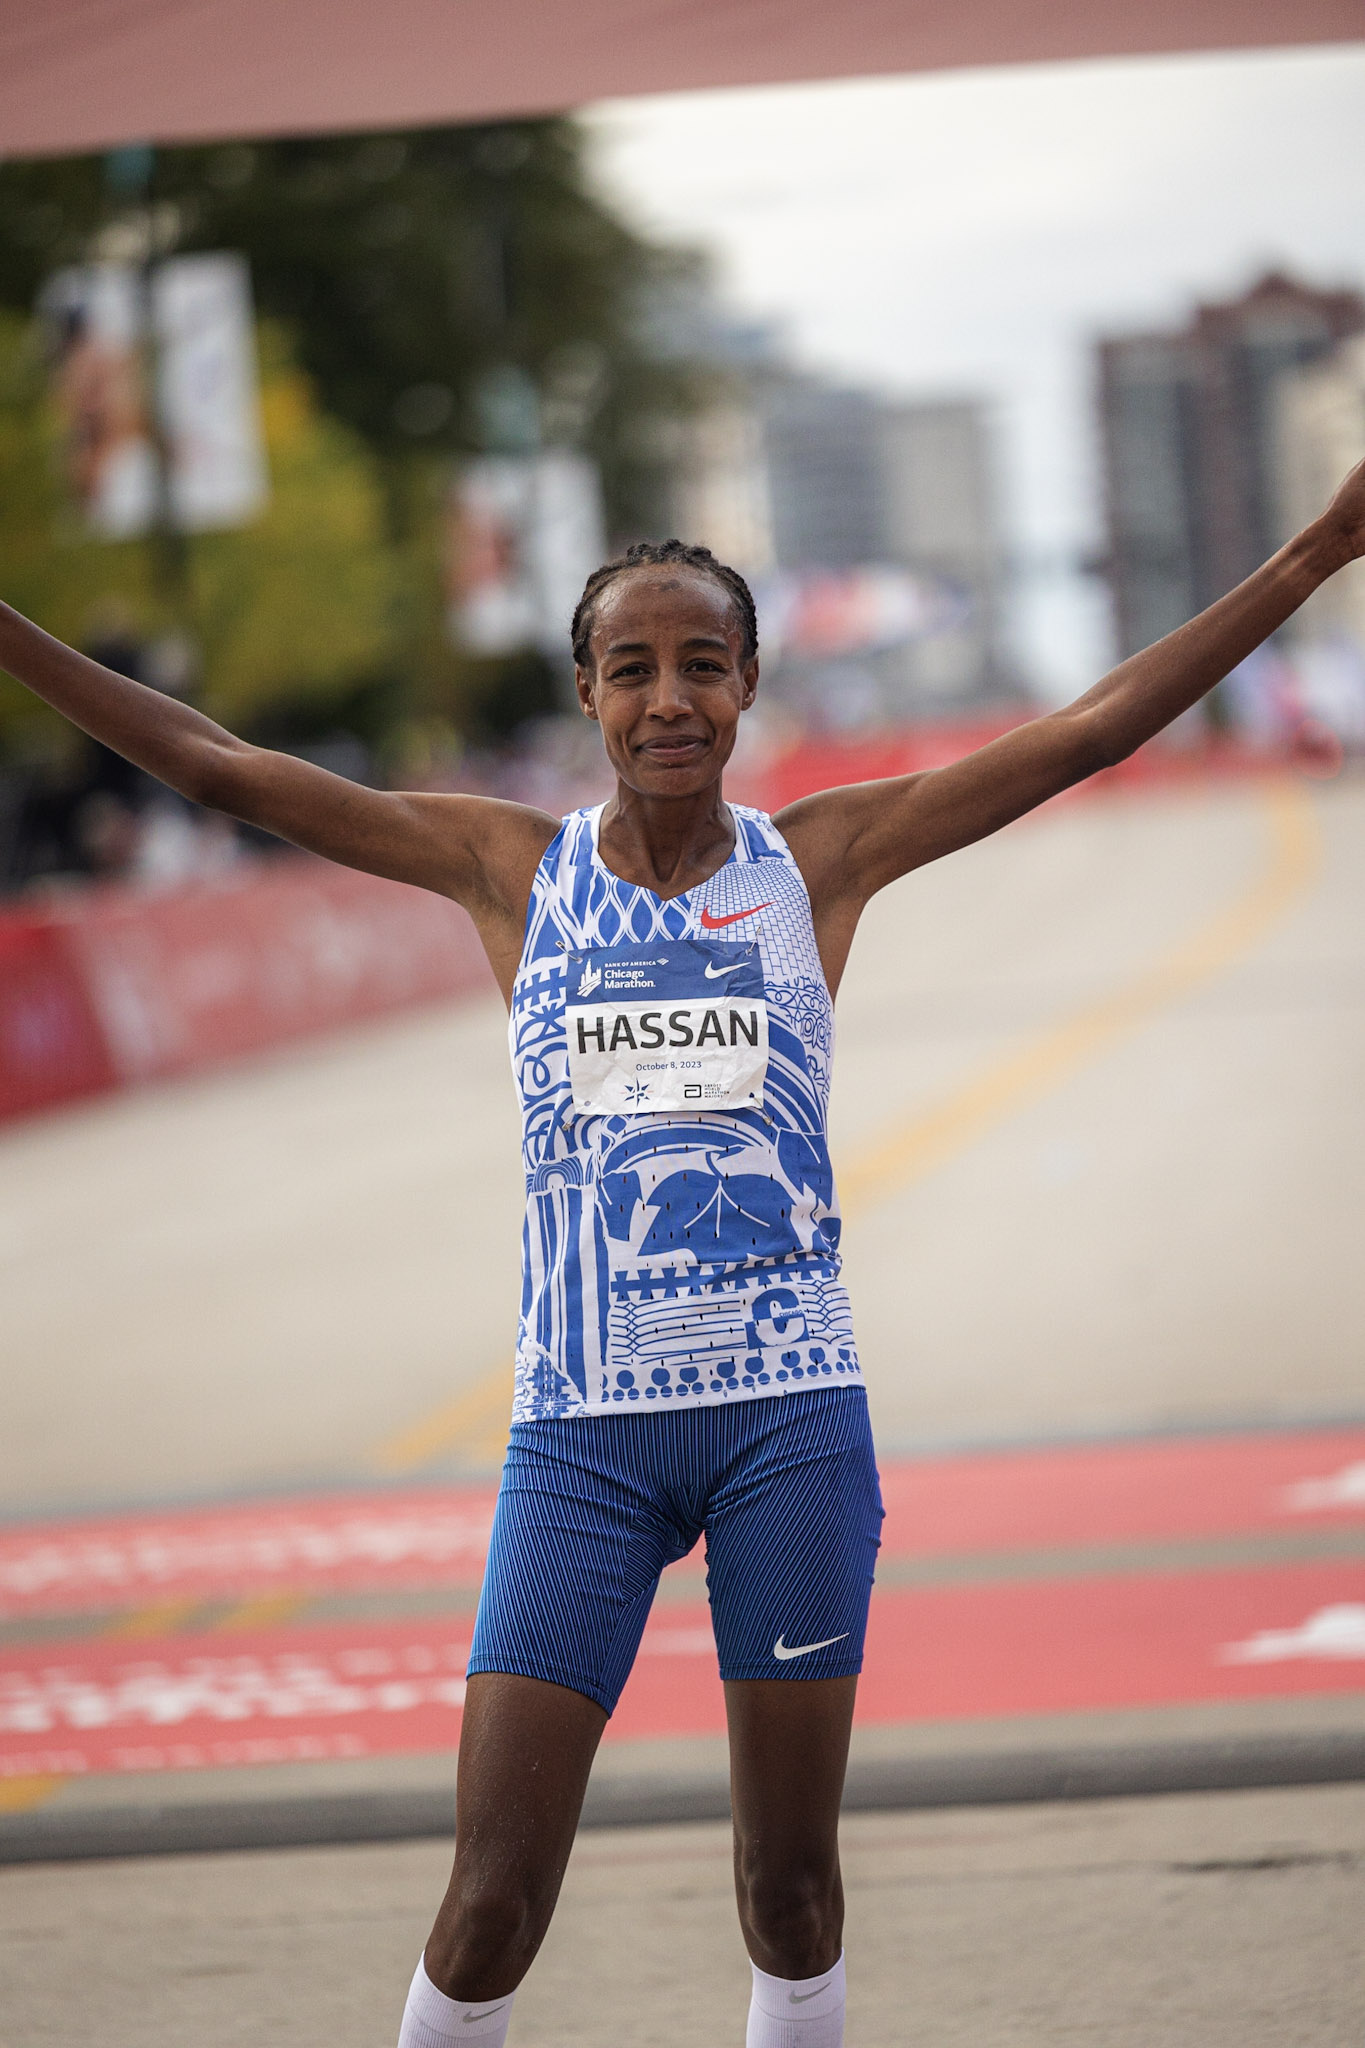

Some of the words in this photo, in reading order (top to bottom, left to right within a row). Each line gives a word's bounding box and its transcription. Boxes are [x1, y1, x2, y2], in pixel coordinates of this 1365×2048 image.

[604, 969, 645, 980] Chicago
[576, 1009, 759, 1054] HASSAN
[635, 1062, 669, 1071] October
[670, 1061, 678, 1070] 8,
[680, 1060, 702, 1069] 2023
